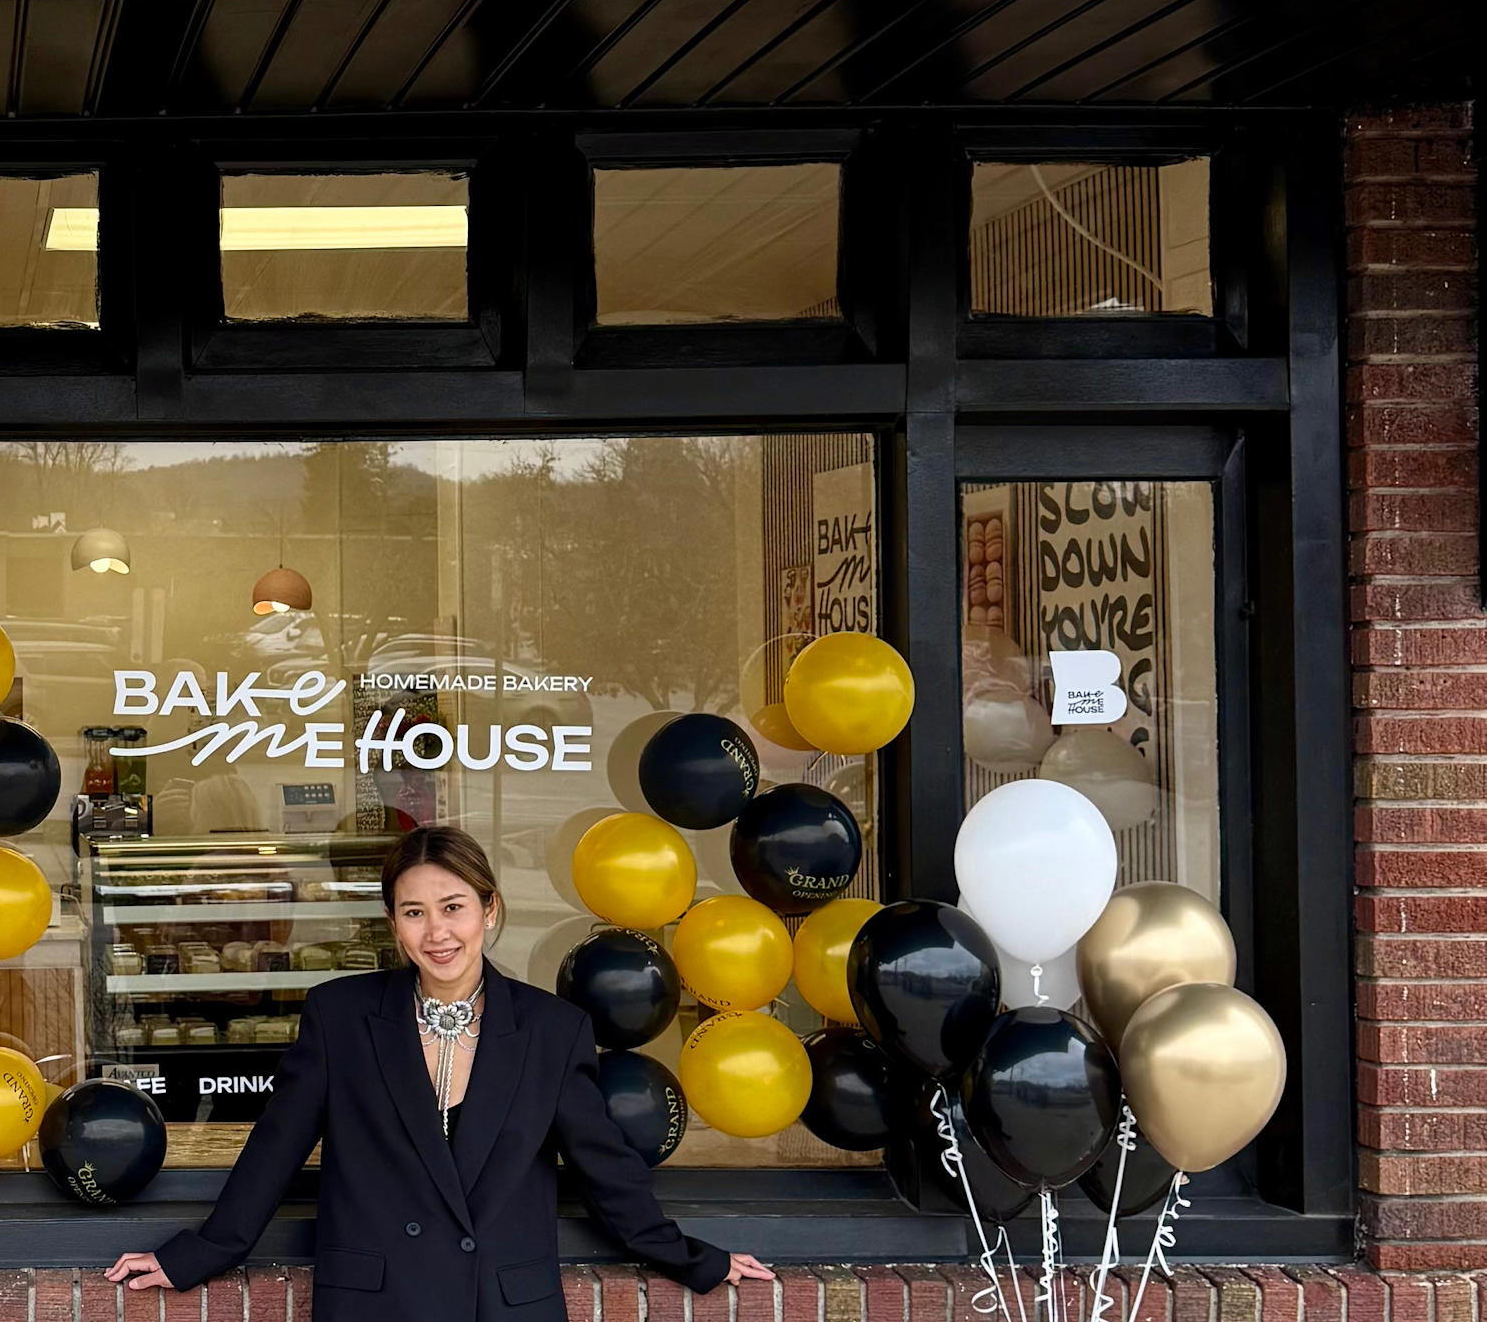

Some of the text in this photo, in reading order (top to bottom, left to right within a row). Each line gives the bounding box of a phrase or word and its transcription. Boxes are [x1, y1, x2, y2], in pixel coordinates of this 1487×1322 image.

[1040, 482, 1151, 534] SLOW
[1040, 526, 1151, 592] DOWN
[818, 586, 872, 635] HOUS
[1041, 593, 1153, 655] YOU'RE
[360, 673, 593, 692] HOMEMADE BAKERY
[1067, 703, 1105, 714] HOUSE
[355, 707, 593, 774] HOUSE
[720, 739, 754, 791] GRAND
[789, 873, 850, 889] GRAND
[2, 1072, 34, 1119] GRAND
[665, 1086, 680, 1150] GRAND
